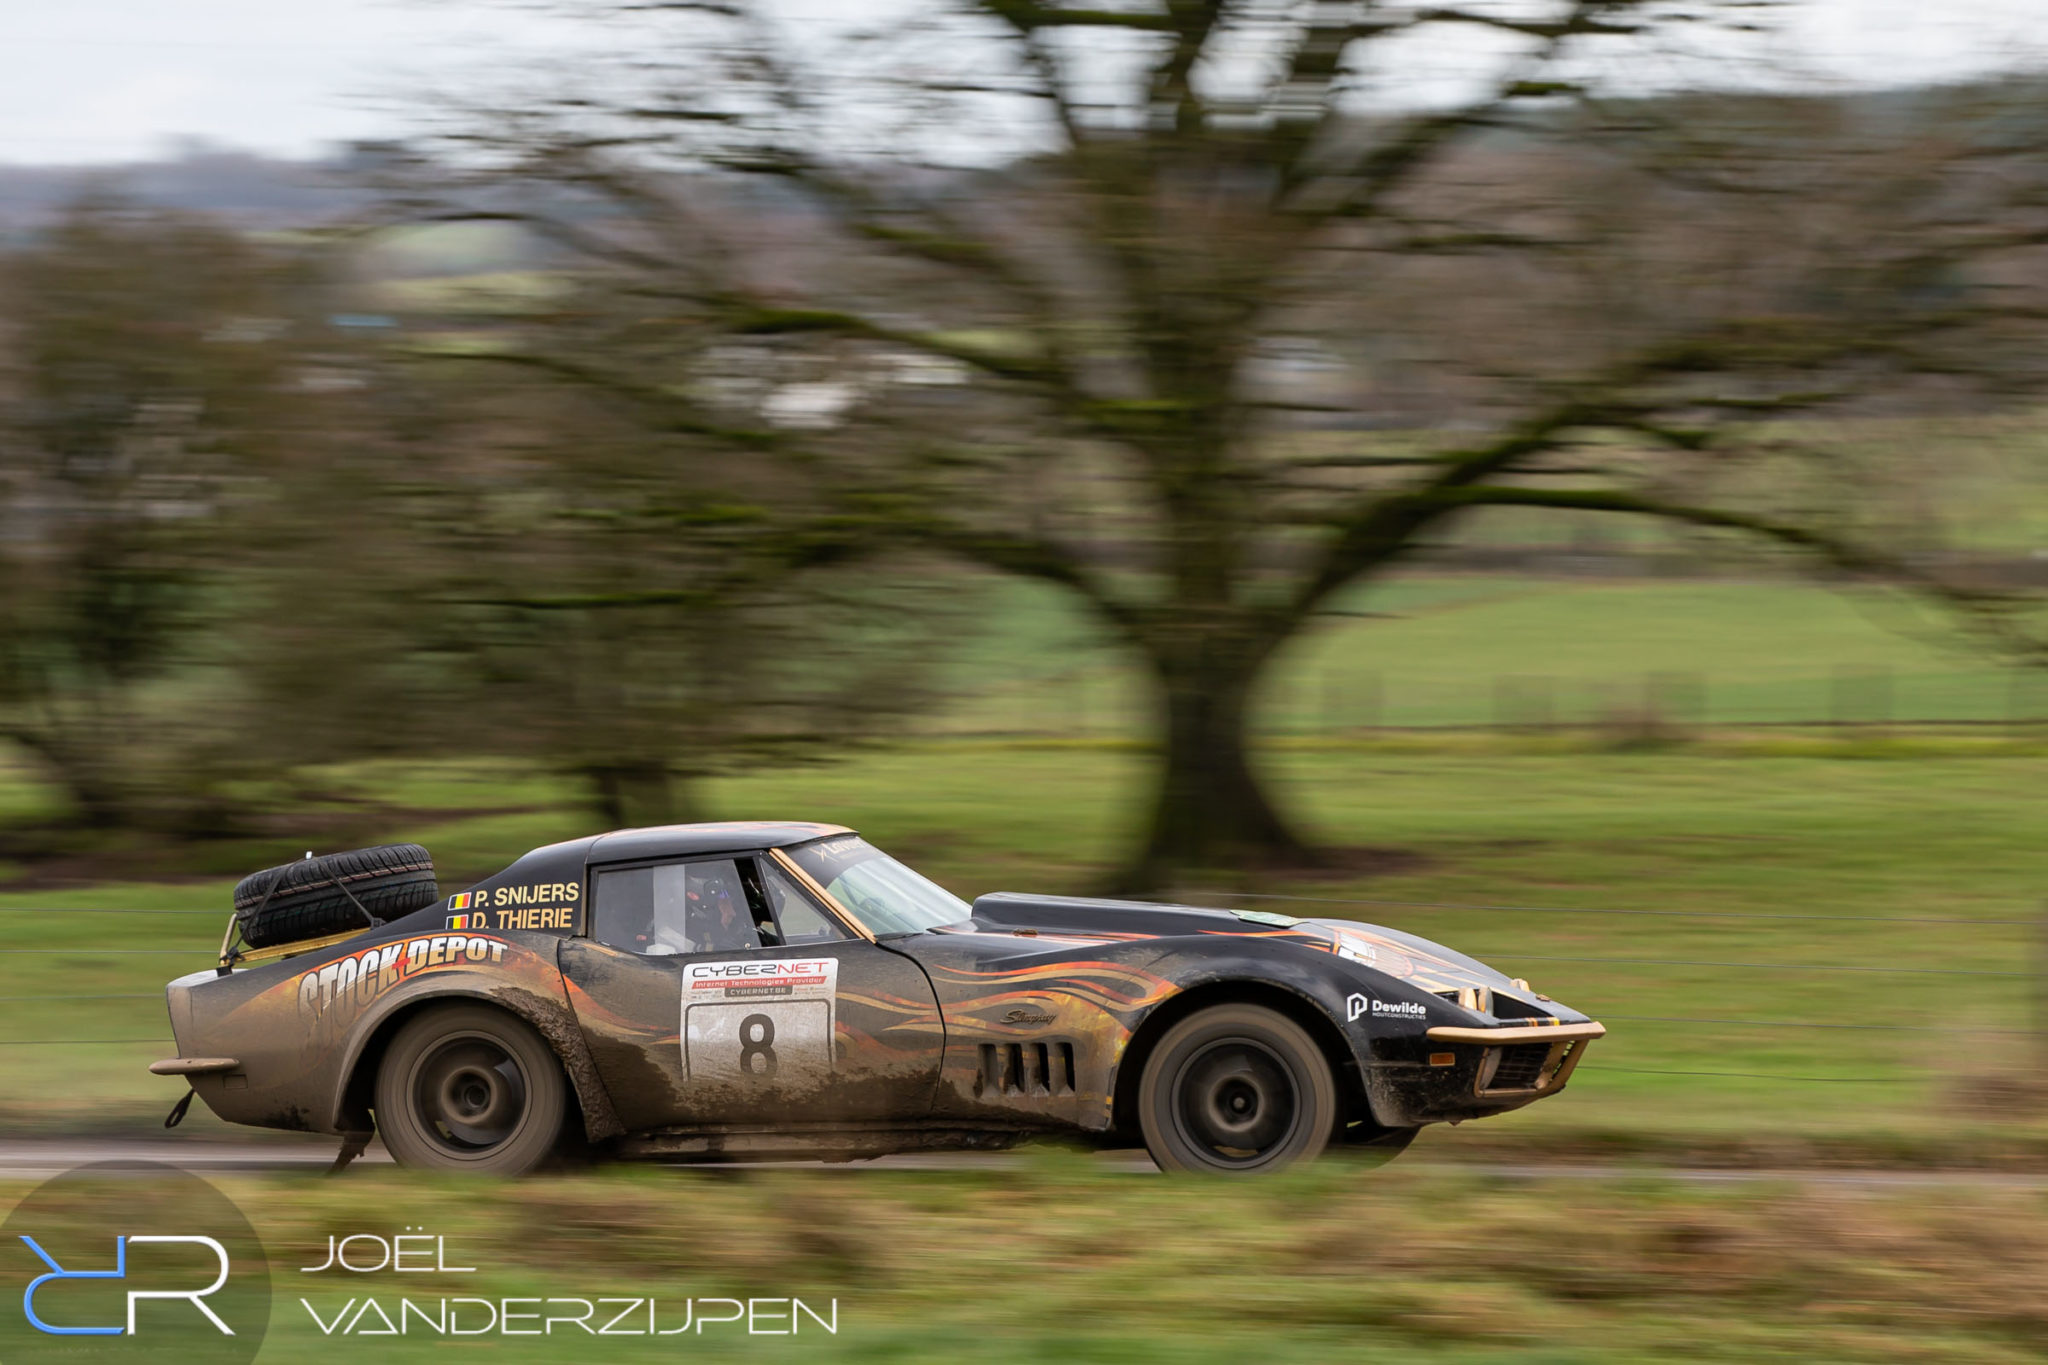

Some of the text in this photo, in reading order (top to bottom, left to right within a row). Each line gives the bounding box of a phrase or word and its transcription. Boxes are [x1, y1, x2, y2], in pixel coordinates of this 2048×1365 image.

[474, 882, 580, 908] P. SNIJERS
[472, 907, 574, 930] D. THIERIE
[692, 962, 830, 978] CYBERNET
[787, 976, 823, 984] Provider
[729, 987, 787, 996] CYBERNET.BE
[1372, 999, 1427, 1015] Dewilde
[738, 1013, 778, 1077] 8
